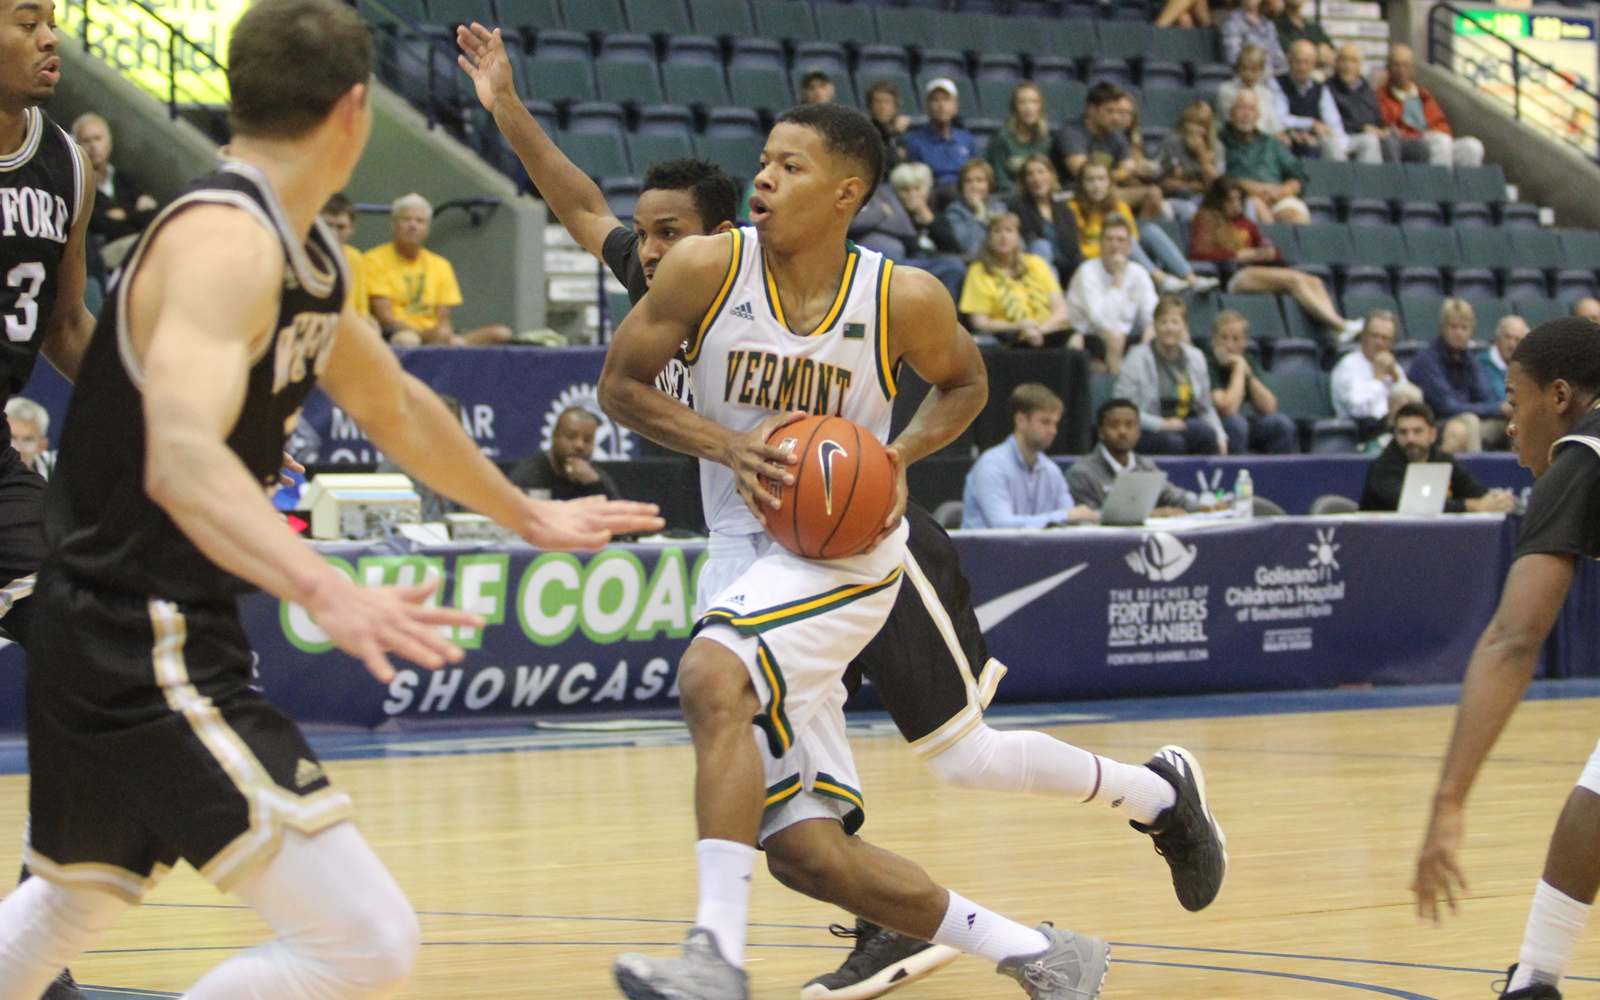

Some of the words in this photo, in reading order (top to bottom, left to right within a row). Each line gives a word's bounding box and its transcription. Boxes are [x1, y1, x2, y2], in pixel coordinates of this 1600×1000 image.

[723, 350, 853, 418] VERMONT
[1255, 565, 1318, 586] Golisano
[519, 551, 699, 642] COA
[1109, 588, 1133, 602] THE
[1225, 586, 1294, 607] Children's
[1296, 581, 1345, 602] Hospital
[1109, 602, 1150, 624] FORT
[1153, 599, 1208, 622] MYERS
[1110, 625, 1137, 641] AND
[1139, 622, 1208, 645] SANIBEL
